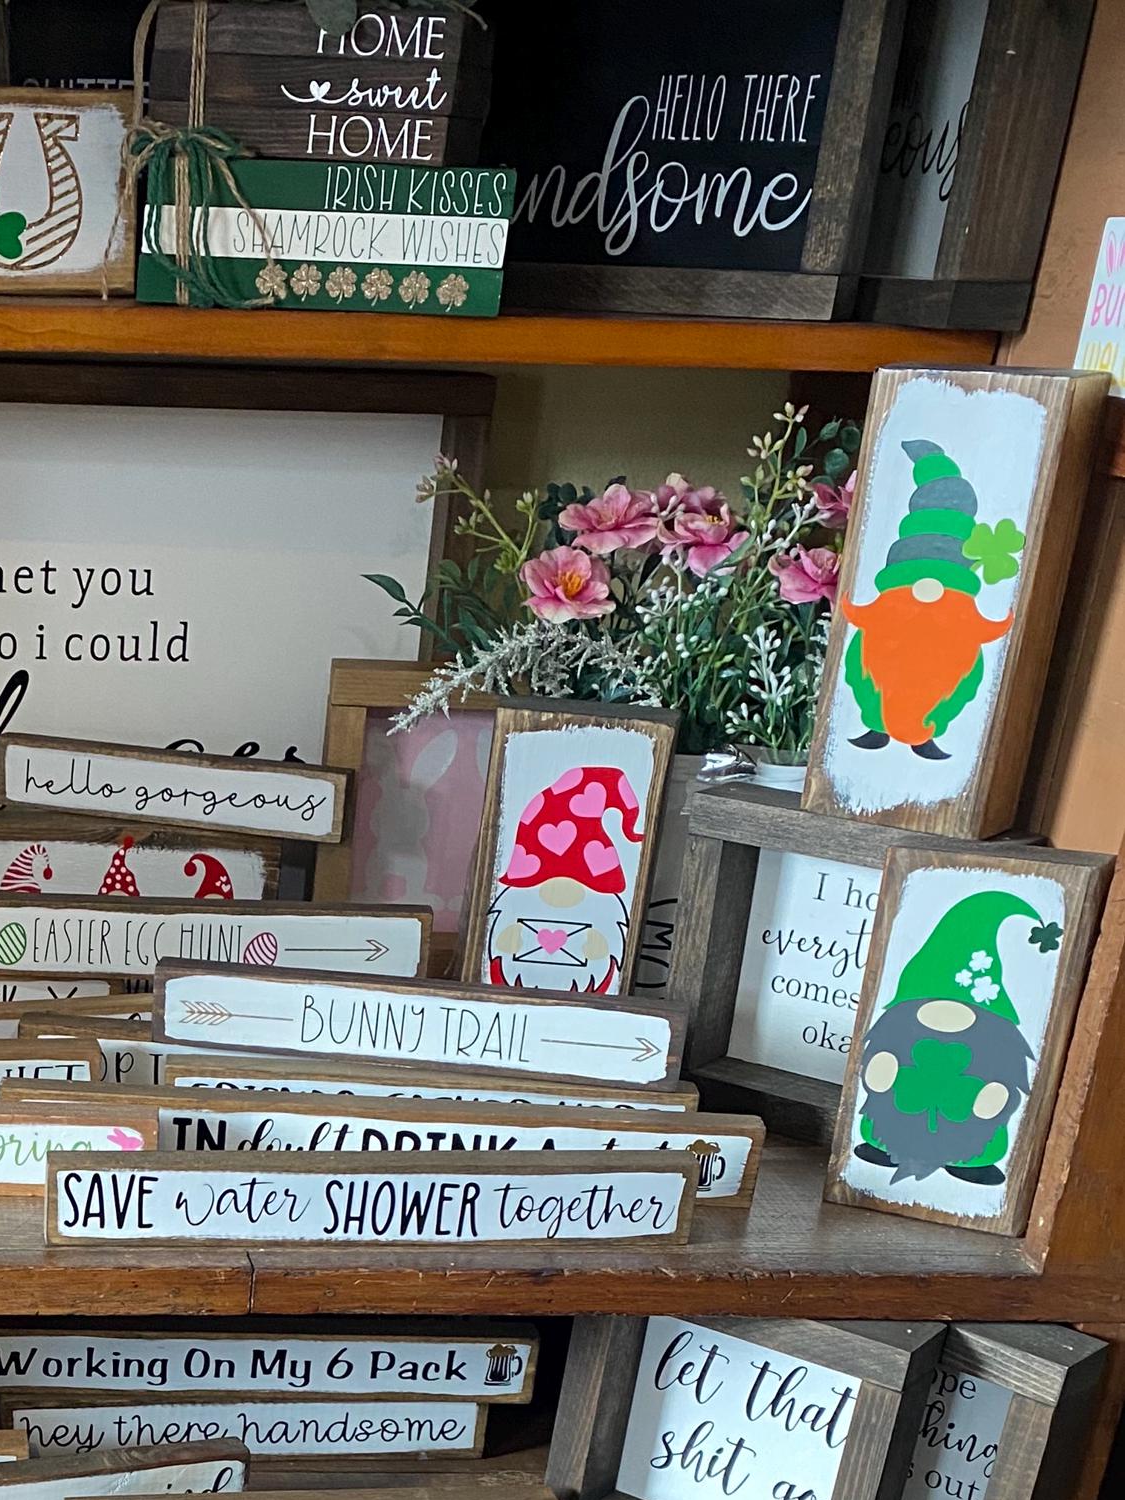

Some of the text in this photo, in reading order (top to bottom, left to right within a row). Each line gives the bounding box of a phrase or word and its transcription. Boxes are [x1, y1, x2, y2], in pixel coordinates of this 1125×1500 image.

[317, 14, 446, 60] HOME
[345, 68, 447, 110] sweet
[652, 74, 821, 142] HELLO THERE
[307, 115, 433, 160] HOME
[323, 166, 507, 216] IRISH KISSES
[234, 211, 505, 265] SHAMROCK WISHES
[73, 566, 154, 608] you
[35, 626, 49, 660] i
[65, 621, 190, 663] could
[25, 758, 327, 830] hello gorgeous
[813, 872, 827, 901] I
[32, 918, 112, 965] EASTER
[301, 995, 530, 1062] BUNNY TRAIL
[63, 1173, 678, 1241] SAVE water SHOWER together
[183, 1347, 236, 1380] On
[250, 1350, 311, 1386] My
[327, 1350, 353, 1380] 6
[370, 1349, 467, 1382] Pack
[654, 1331, 856, 1448] let that
[20, 1413, 465, 1455] hey there handsome
[651, 1421, 756, 1495] shit
